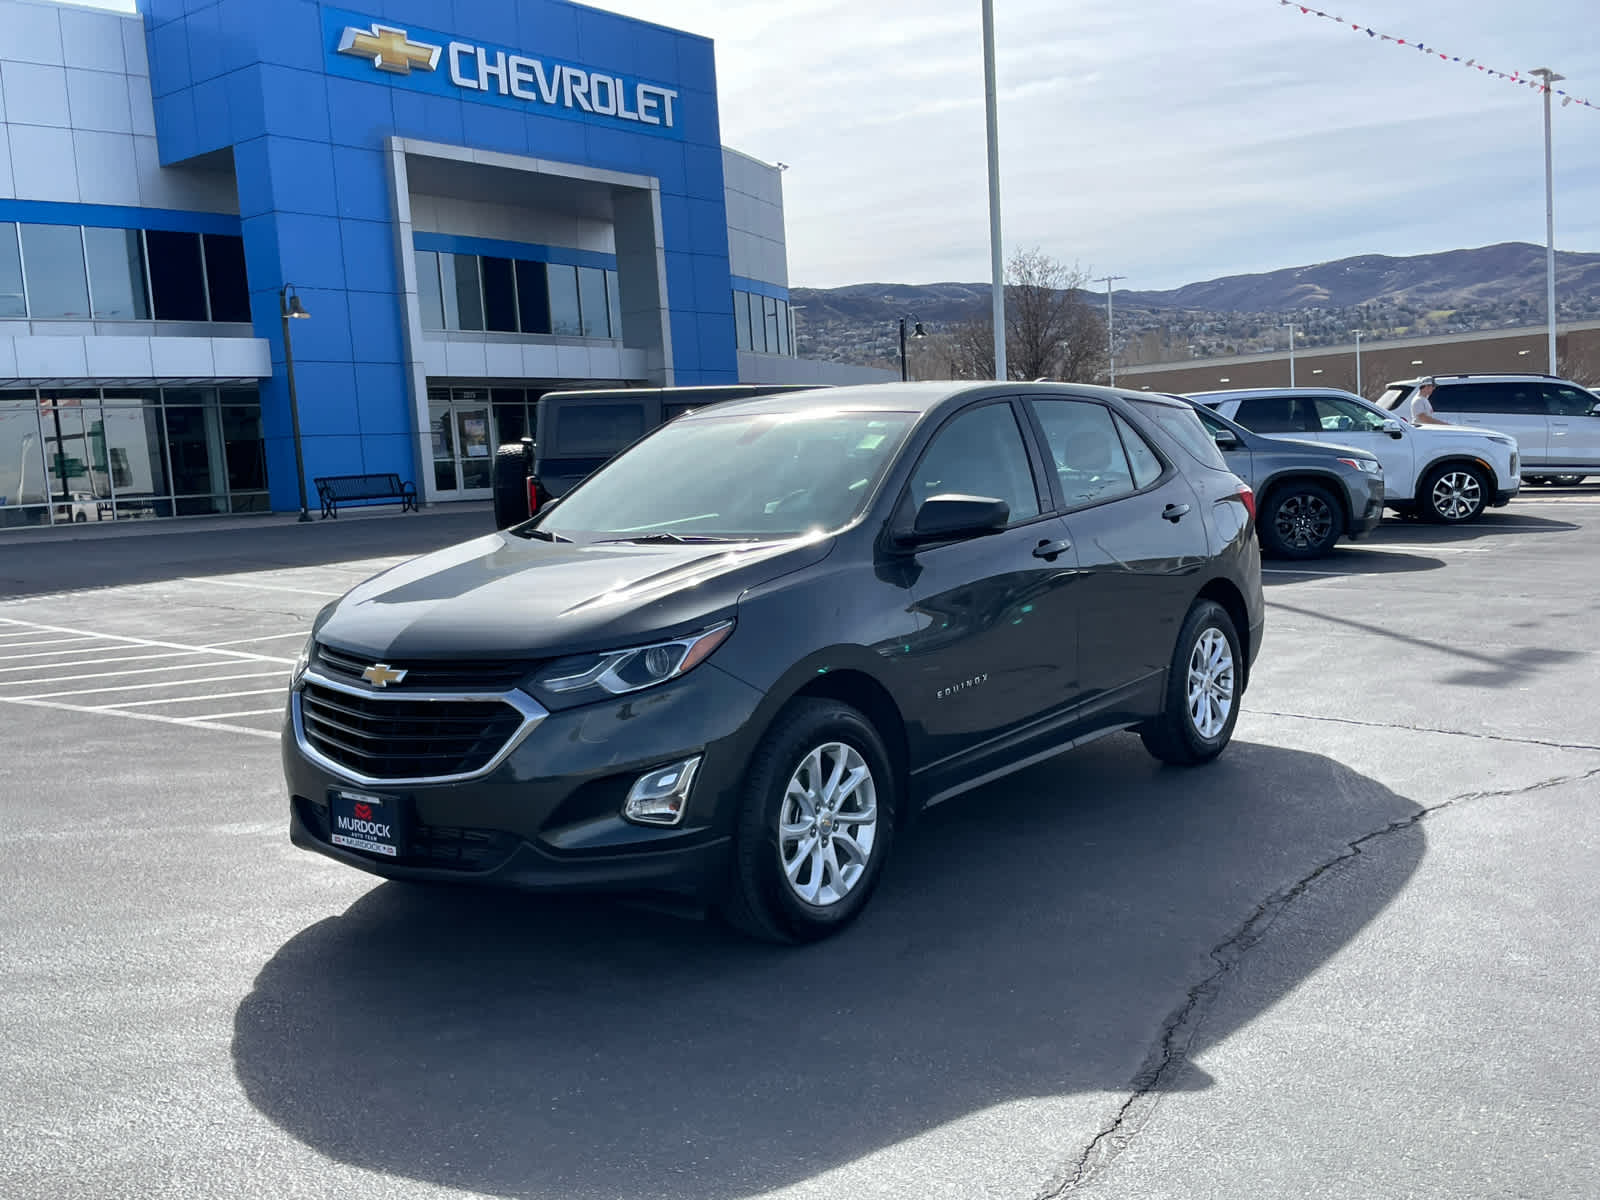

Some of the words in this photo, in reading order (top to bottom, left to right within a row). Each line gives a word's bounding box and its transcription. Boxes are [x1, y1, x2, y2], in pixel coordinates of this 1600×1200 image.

[448, 41, 678, 127] CHEVROLET
[937, 673, 988, 698] EQUINOX
[338, 815, 391, 838] MURDOCK
